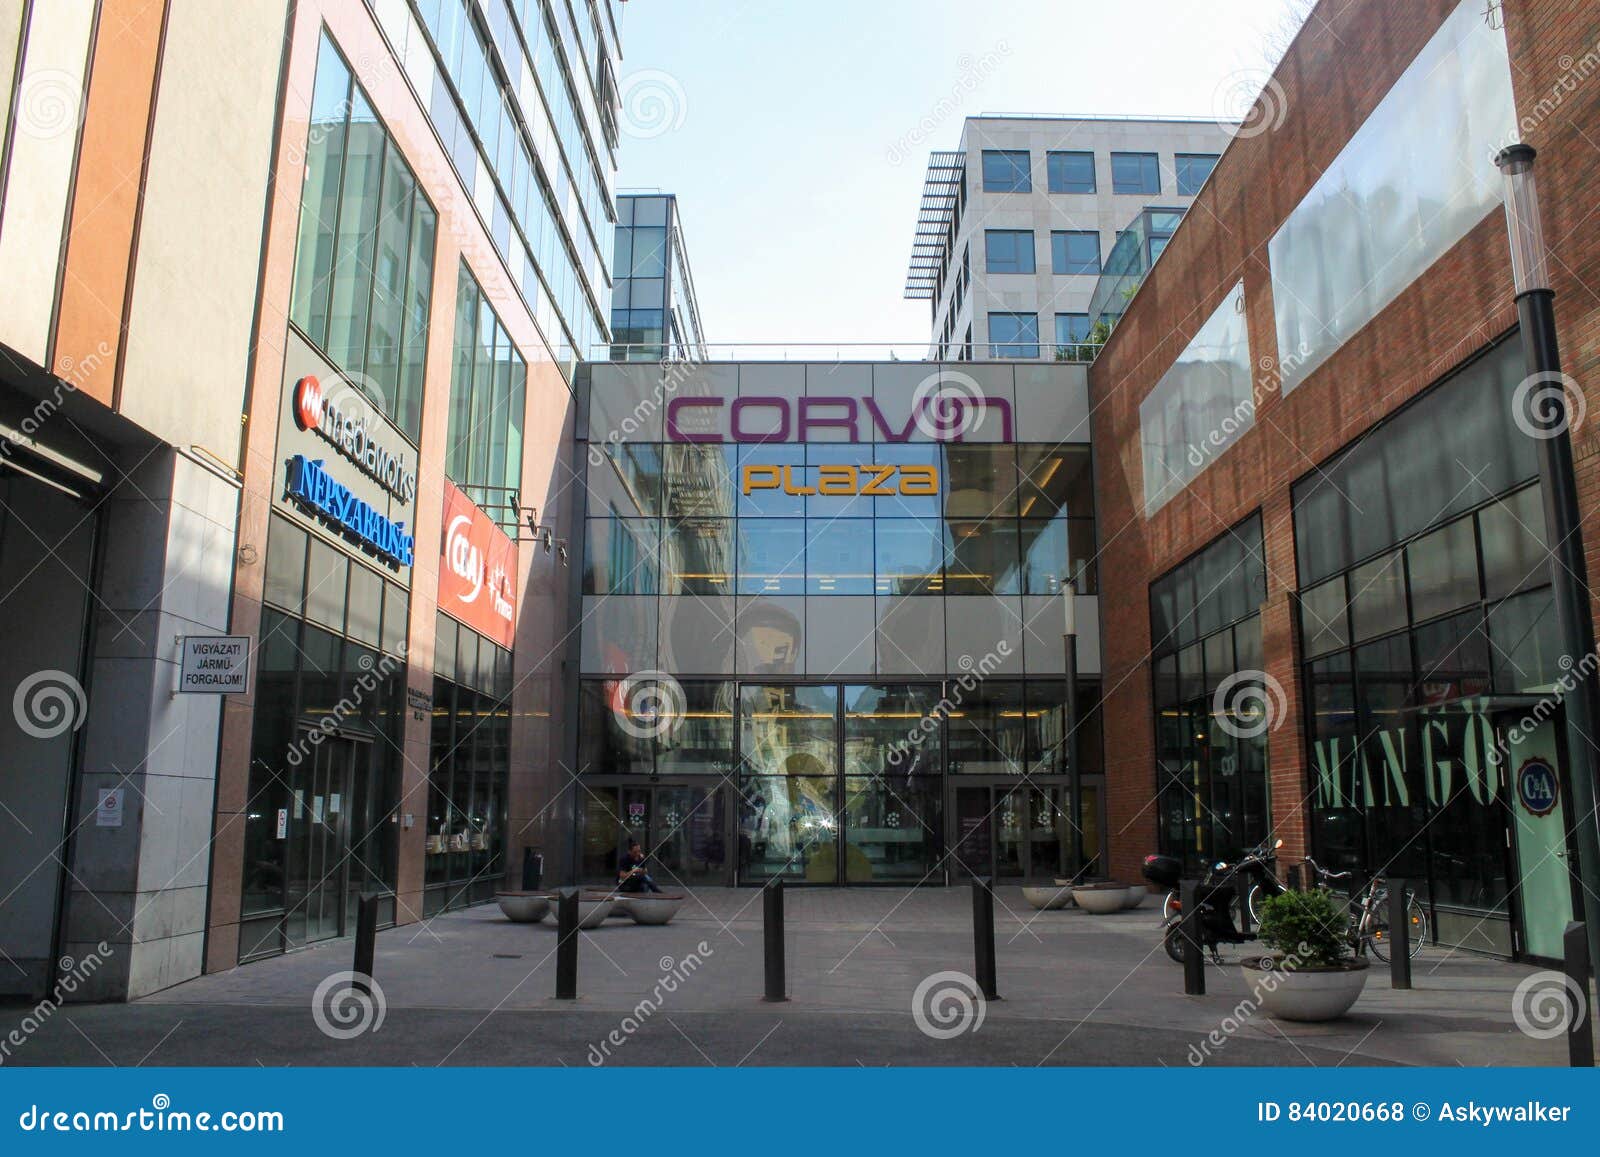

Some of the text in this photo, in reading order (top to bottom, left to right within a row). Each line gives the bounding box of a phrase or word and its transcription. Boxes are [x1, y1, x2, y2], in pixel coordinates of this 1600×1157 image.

[192, 642, 241, 655] VIGYÁZAT!
[186, 673, 243, 685] FORGALOM!
[1313, 712, 1498, 807] MANGO
